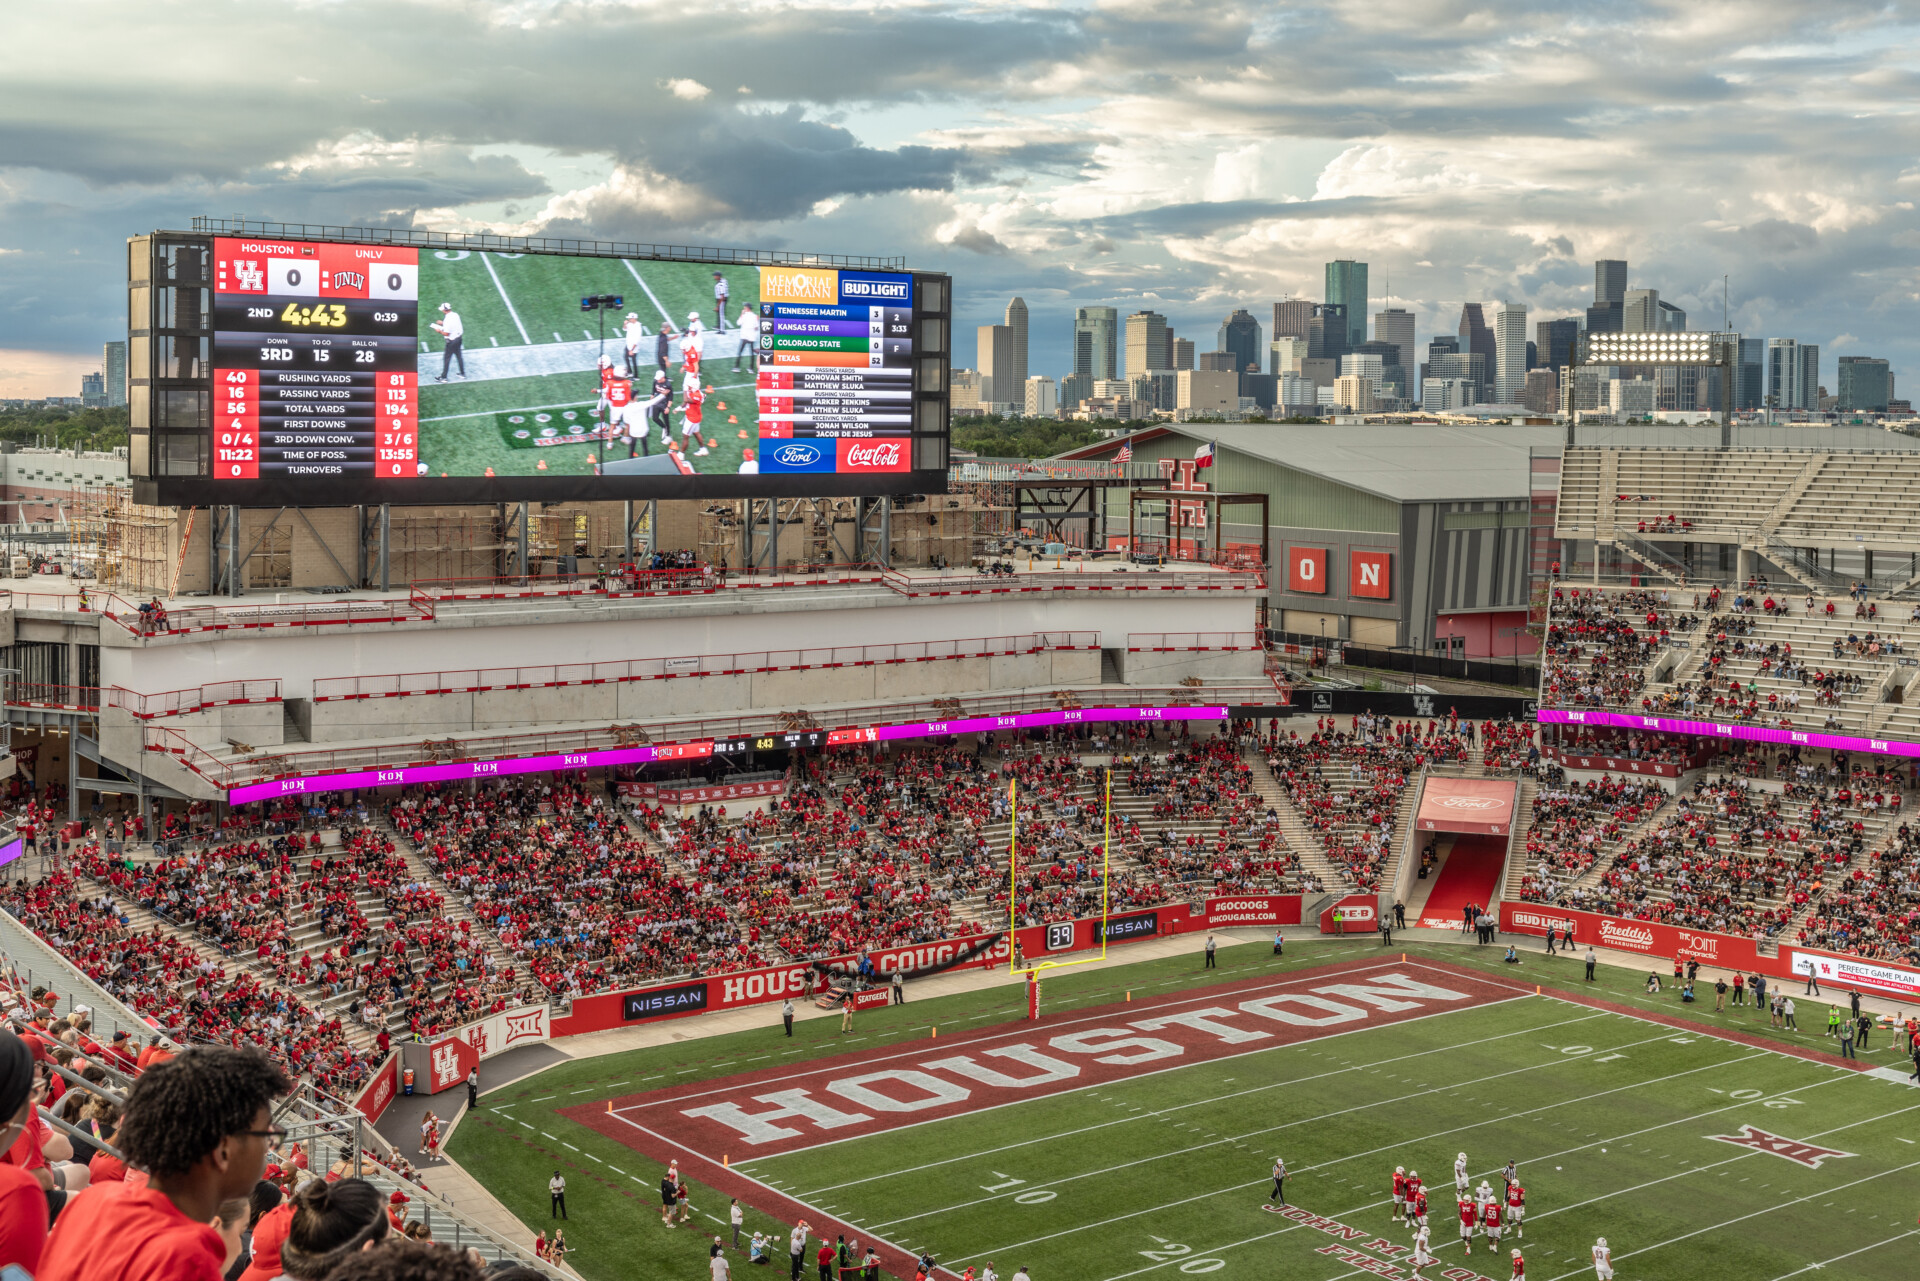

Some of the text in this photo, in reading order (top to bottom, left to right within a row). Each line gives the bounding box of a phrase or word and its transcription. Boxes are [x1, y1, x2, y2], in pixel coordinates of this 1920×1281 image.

[242, 244, 294, 255] HOUSTON
[356, 250, 383, 259] UNLV
[286, 269, 301, 287] 0
[333, 271, 365, 291] UNLV
[387, 273, 402, 291] 0
[767, 274, 832, 291] MEMORIAL
[766, 285, 832, 298] HERMANN
[845, 282, 906, 297] BUD LIGHT
[247, 307, 274, 318] 2ND
[281, 303, 347, 327] 4:43
[374, 312, 398, 322] 0:39
[778, 307, 847, 317] TENNESSEE MARTIN
[777, 323, 829, 332] KANSAS STATE
[777, 339, 841, 348] COLORADO STATE
[261, 348, 293, 361] 3RD
[313, 349, 330, 361] 15
[355, 350, 375, 362] 28
[226, 372, 247, 383] 40
[279, 374, 351, 383] RUSHING YARDS
[390, 375, 405, 385] 81
[228, 387, 244, 398] 16
[279, 389, 350, 398] PASSING YARDS
[387, 389, 407, 400] 113
[227, 402, 246, 414] 56
[285, 405, 345, 413] TOTAL YARDS
[385, 404, 409, 415] 194
[231, 418, 242, 429] 4
[284, 420, 346, 428] FIRST DOWNS
[392, 419, 401, 430] 9
[275, 435, 355, 444] 3RD DOWN CONV.
[219, 449, 253, 460] 11:22
[283, 451, 347, 459] TIME OF POSS.
[380, 449, 413, 460] 13:55
[781, 447, 812, 463] Ford
[847, 444, 901, 466] Coca-Cola
[231, 464, 242, 476] 0
[288, 466, 342, 474] TURNOVERS
[392, 464, 401, 475] 0
[1300, 558, 1380, 586] O N
[856, 731, 861, 739] 0
[714, 744, 727, 752] 3RD
[737, 742, 746, 750] 15
[757, 738, 773, 749] 4:43
[659, 747, 673, 758] UNLV
[679, 747, 683, 755] 0
[1444, 798, 1492, 808] Ford
[1215, 901, 1269, 912] #GOCOOGS
[1209, 912, 1277, 924] UHCOUGARS.COM
[1515, 914, 1574, 932] BUD LIGH
[1101, 918, 1153, 935] NISSAN
[1599, 920, 1653, 942] Freddy's
[1052, 927, 1070, 946] 39
[1678, 932, 1691, 941] THE
[1604, 939, 1650, 950] STEAKBURGERS
[1689, 936, 1717, 952] JOINT
[881, 936, 1010, 976] COUGARS
[1678, 948, 1718, 960] chiropractic
[1838, 963, 1915, 983] PERFECT GAME PLAN
[1858, 976, 1876, 984] TEQUILA
[1891, 982, 1914, 990] ATHLETICS
[632, 991, 701, 1013] NISSAN
[857, 991, 888, 1005] SEATGEEK
[680, 973, 1473, 1145] HOUSTON
[1487, 1210, 1497, 1220] 59
[1261, 1203, 1411, 1259] JOHN M.
[1138, 1243, 1226, 1274] 20
